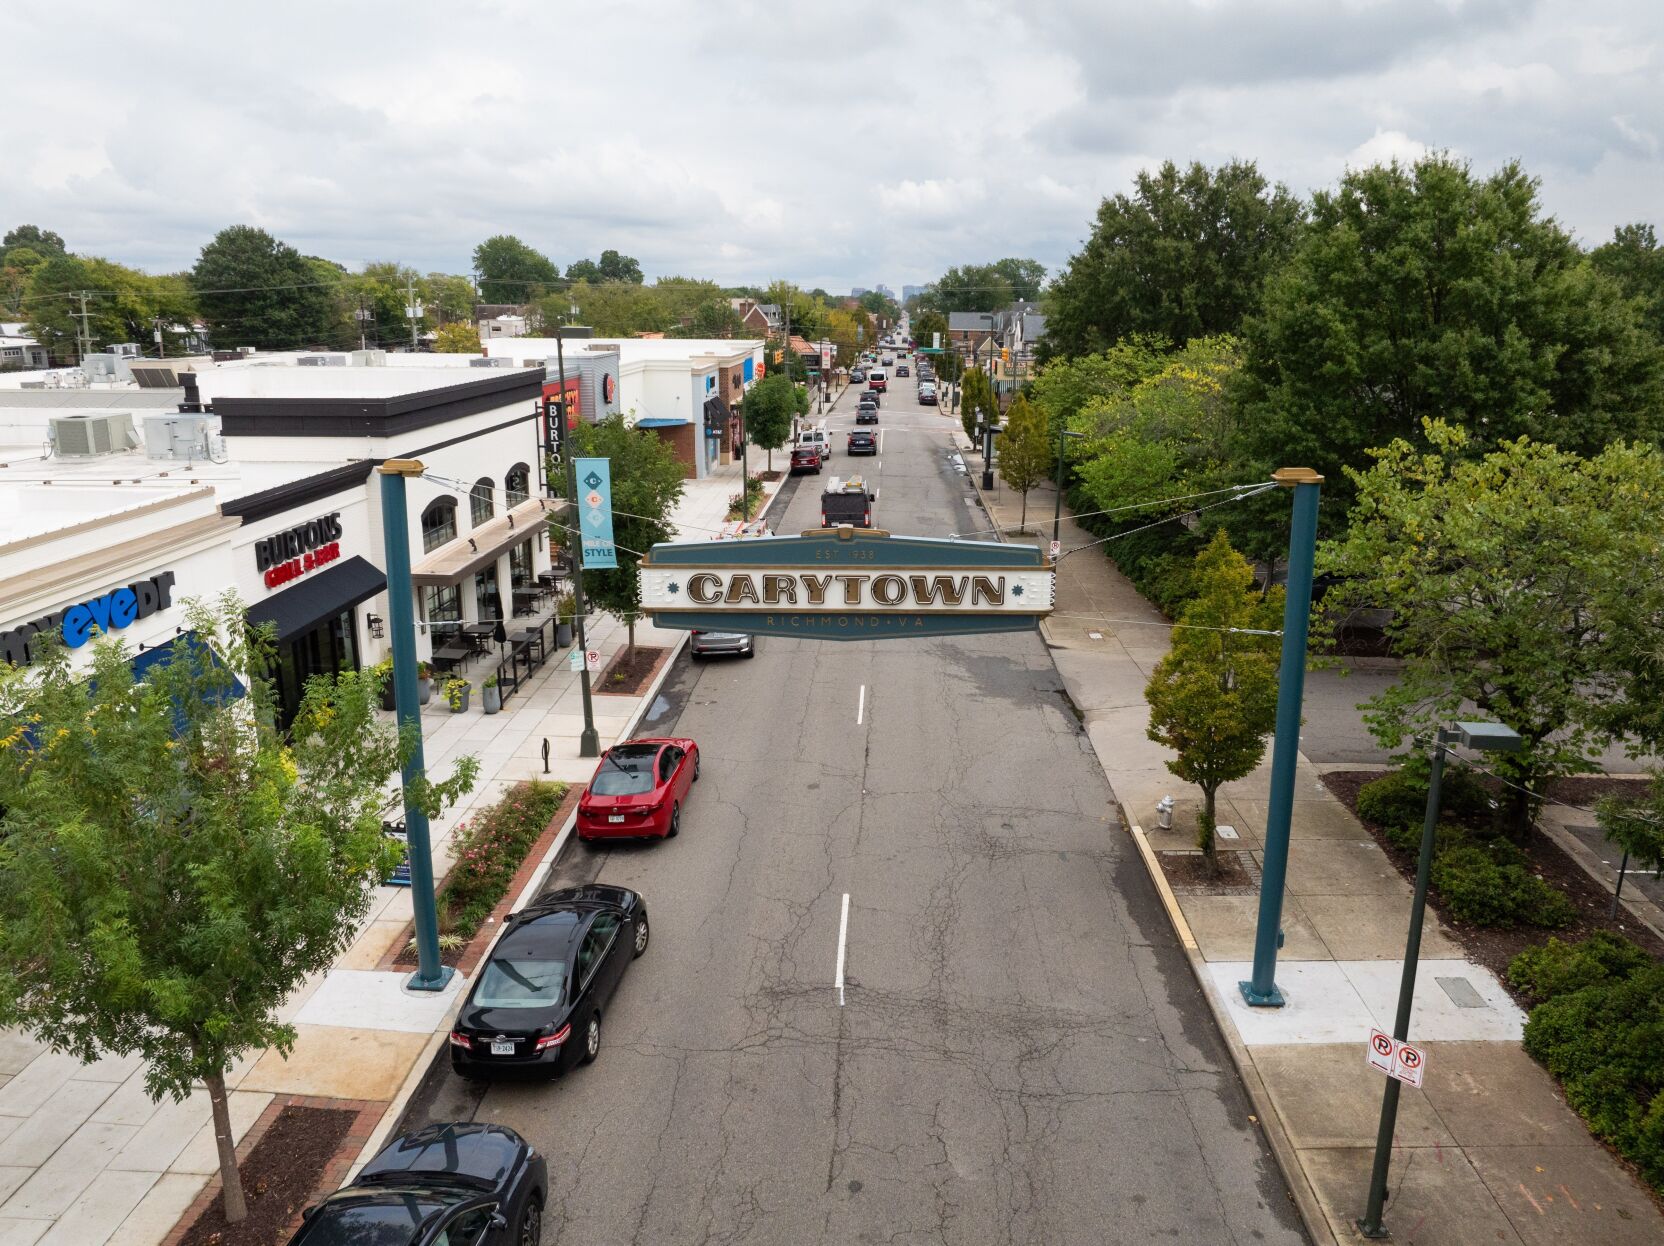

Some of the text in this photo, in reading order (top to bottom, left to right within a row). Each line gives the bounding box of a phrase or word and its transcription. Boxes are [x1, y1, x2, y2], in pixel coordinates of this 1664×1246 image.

[255, 512, 342, 574] BURTONS
[584, 548, 613, 557] STYLE
[815, 549, 839, 560] EST
[687, 573, 1006, 606] CARYTOWN
[767, 616, 924, 627] RICHMOND VA
